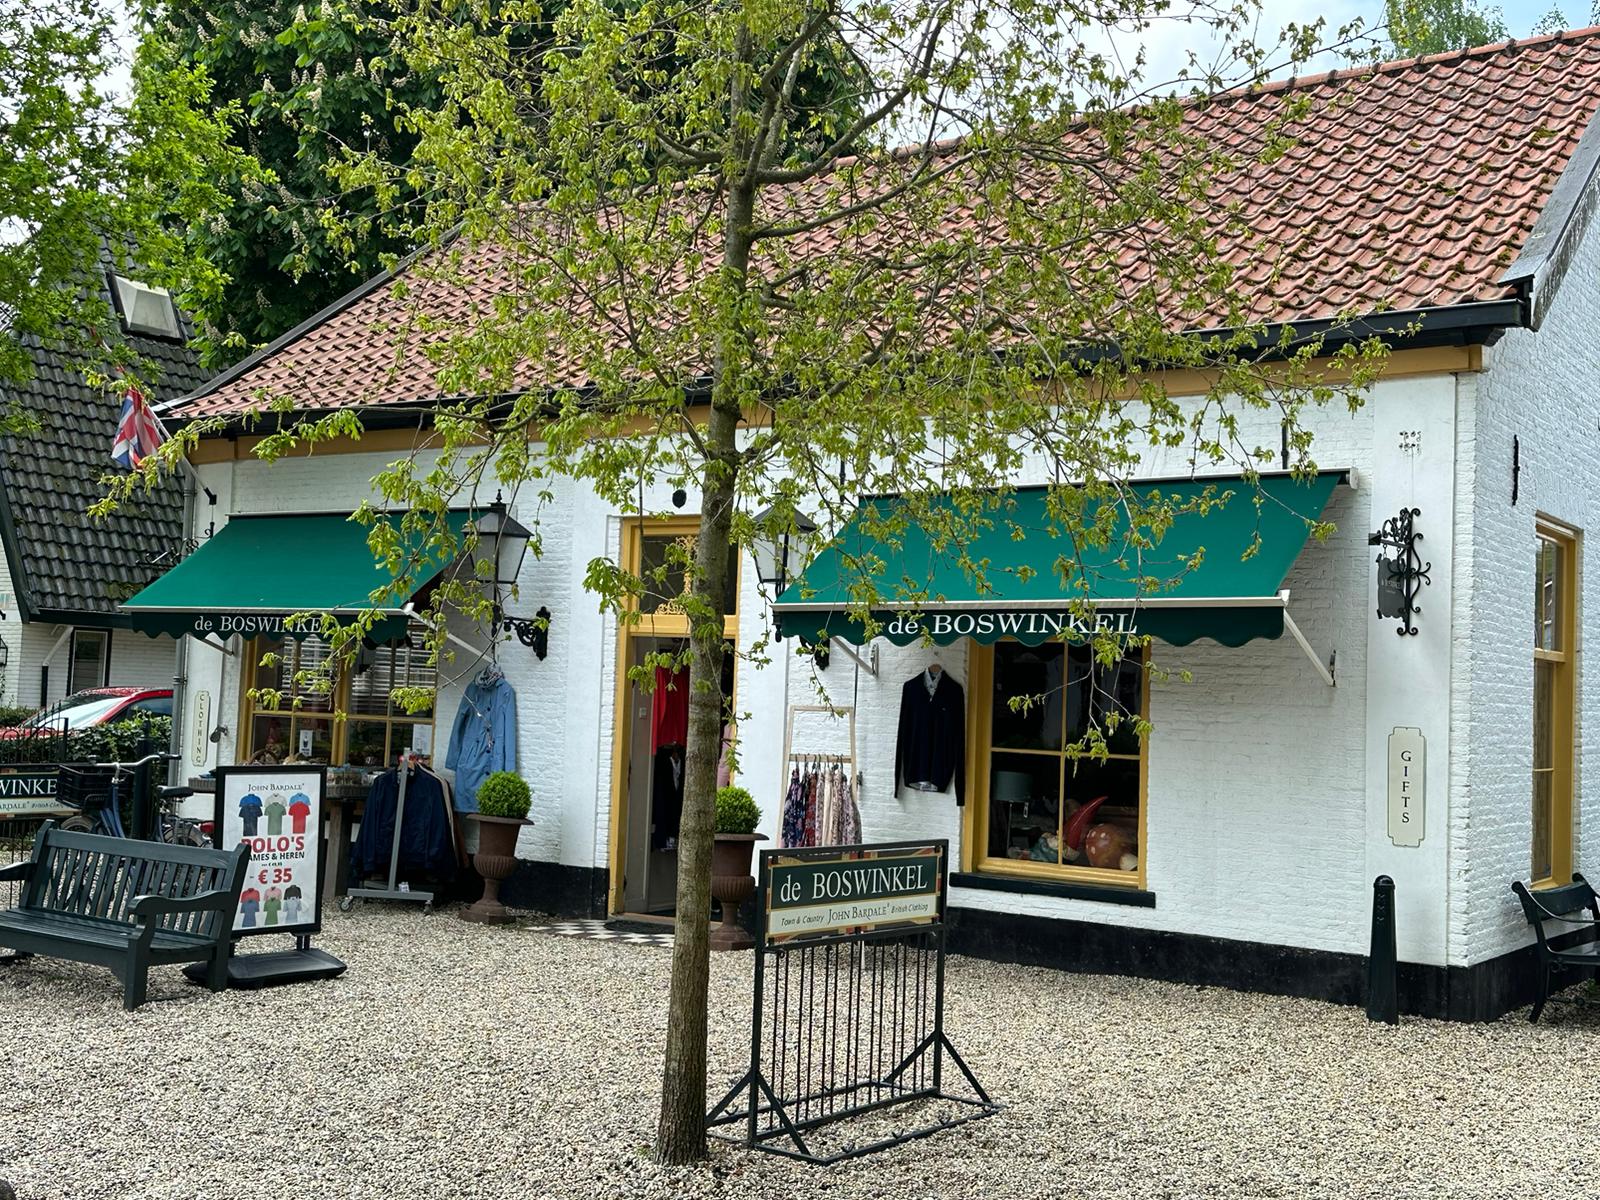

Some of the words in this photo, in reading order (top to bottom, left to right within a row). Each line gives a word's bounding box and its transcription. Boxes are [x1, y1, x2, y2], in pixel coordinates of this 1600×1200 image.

[194, 615, 213, 631] de
[219, 615, 327, 633] BOSWINKE
[888, 617, 918, 635] de
[931, 613, 1138, 635] BOSWINKEL
[195, 693, 205, 763] CLOTHING
[248, 783, 269, 792] JOHN
[1400, 750, 1412, 823] GIFTS
[249, 853, 270, 861] AMES
[279, 851, 305, 860] HEREN
[257, 869, 268, 884] €
[272, 868, 292, 884] 35
[780, 874, 801, 902] de
[811, 865, 928, 900] BOSWINKEL
[781, 917, 796, 926] Town
[796, 916, 801, 925] &
[802, 914, 825, 924] Country
[827, 908, 851, 925] JOHN
[891, 904, 908, 914] British
